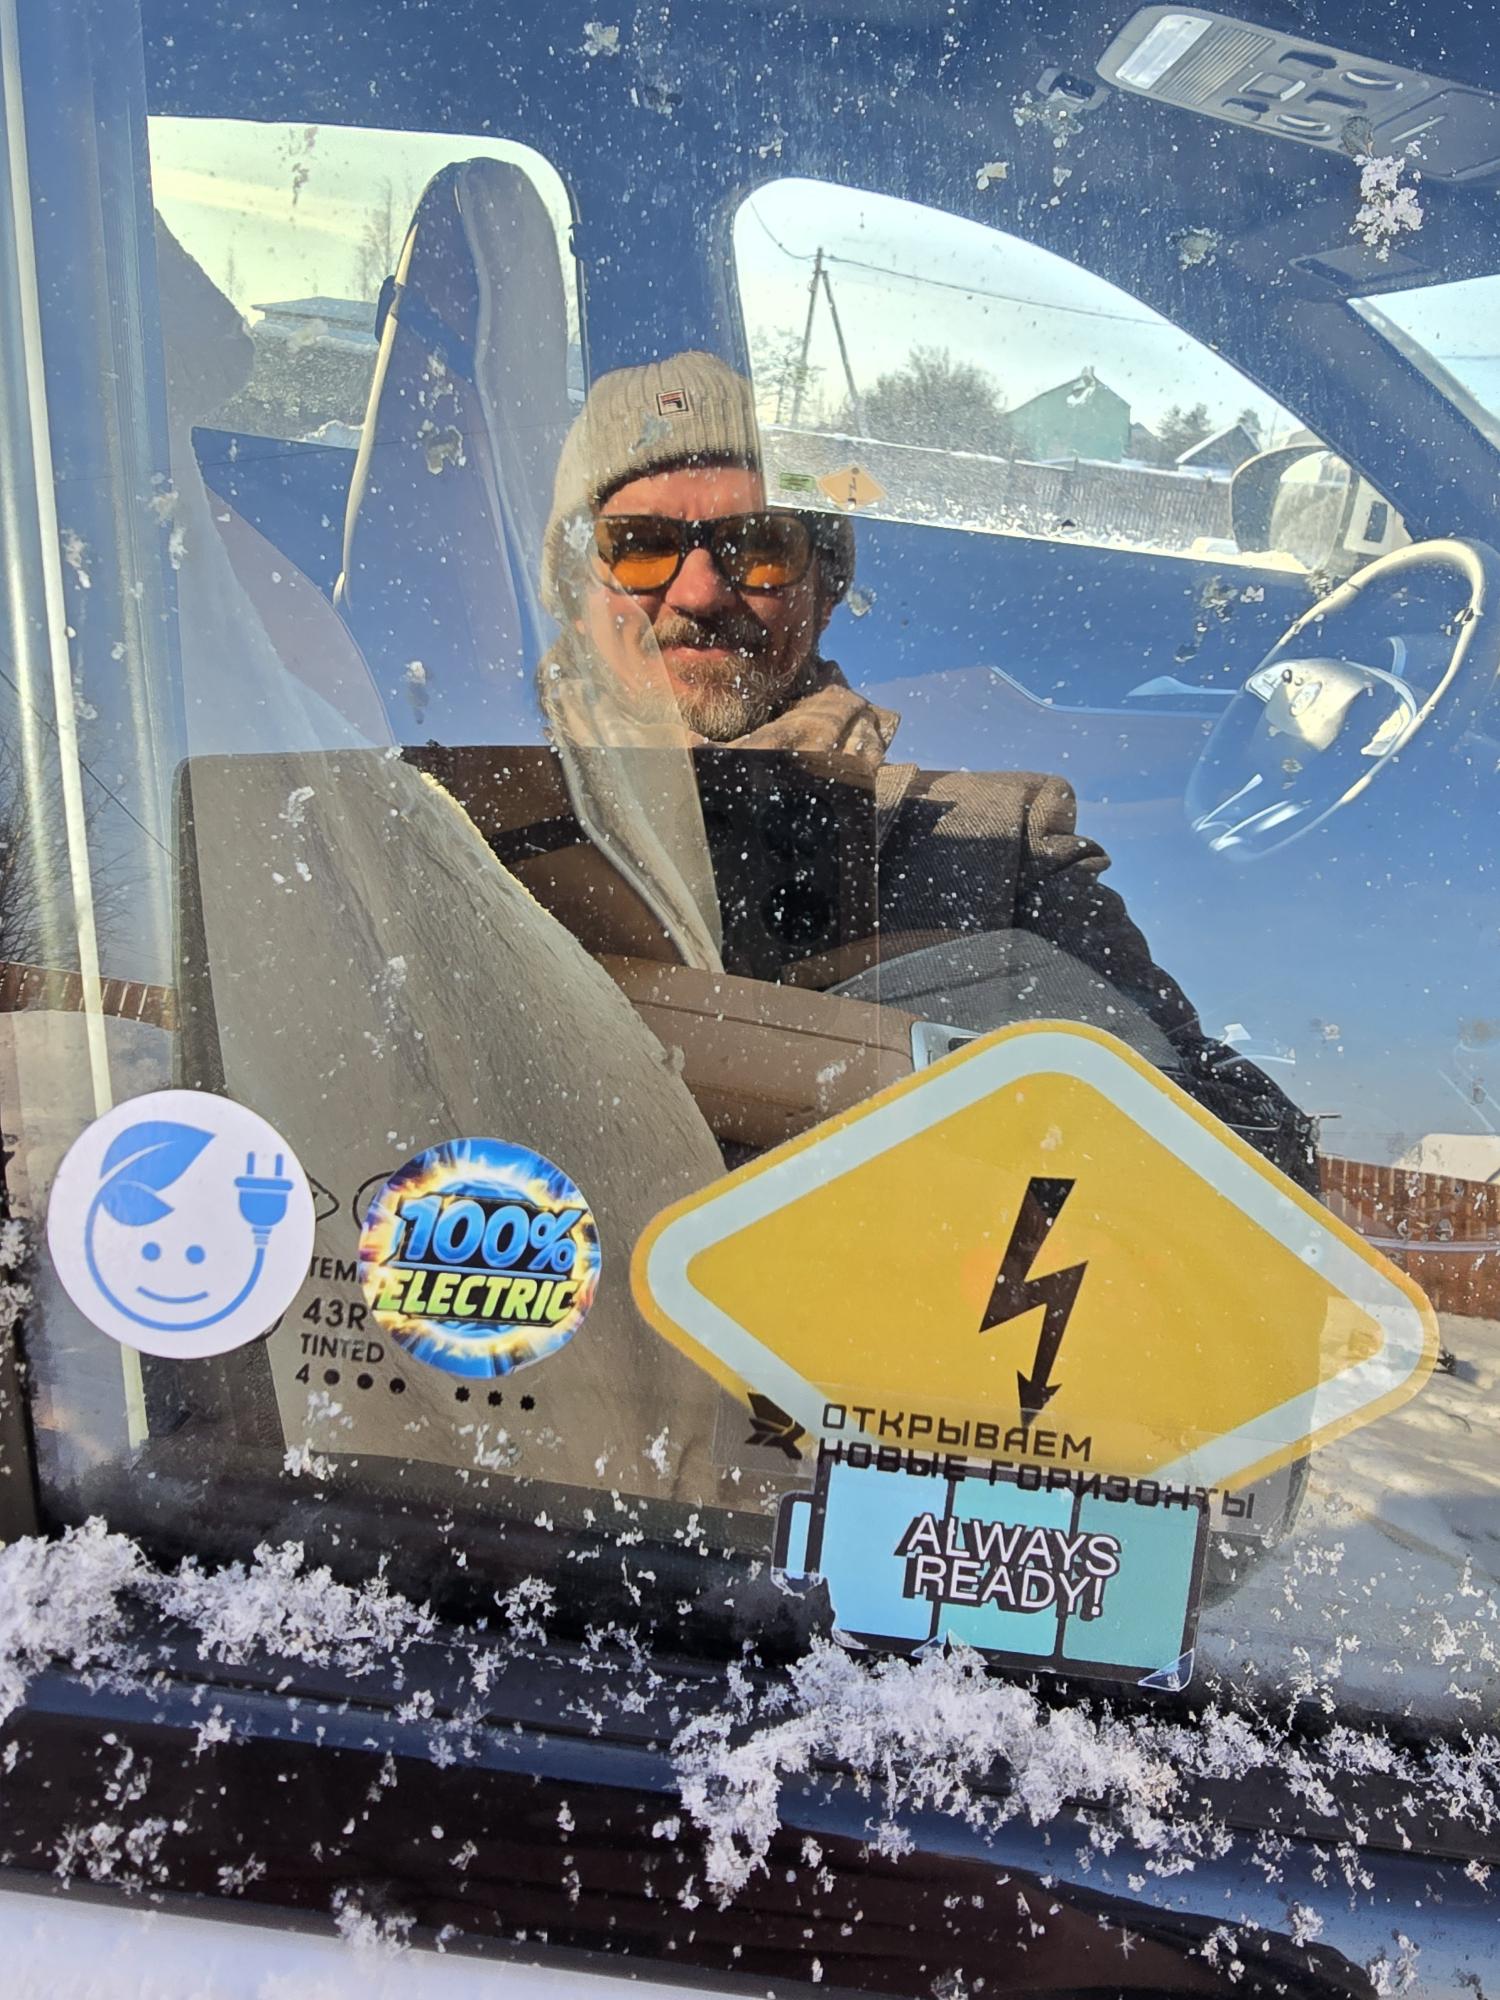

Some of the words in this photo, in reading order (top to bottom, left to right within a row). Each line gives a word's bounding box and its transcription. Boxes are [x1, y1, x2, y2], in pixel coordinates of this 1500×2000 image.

[401, 1195, 584, 1273] 100%
[309, 1255, 361, 1283] TEM
[376, 1269, 581, 1321] ELECTRIC
[303, 1297, 368, 1331] 43R
[301, 1333, 384, 1363] TINTED
[823, 1403, 1092, 1462] ОТКРЫВАЕМ
[818, 1437, 969, 1482] НОВЫЕ
[988, 1459, 1256, 1520] ГОРИЗОНТЫ
[906, 1512, 1120, 1577] ALWAYS
[912, 1553, 1104, 1617] READY!
